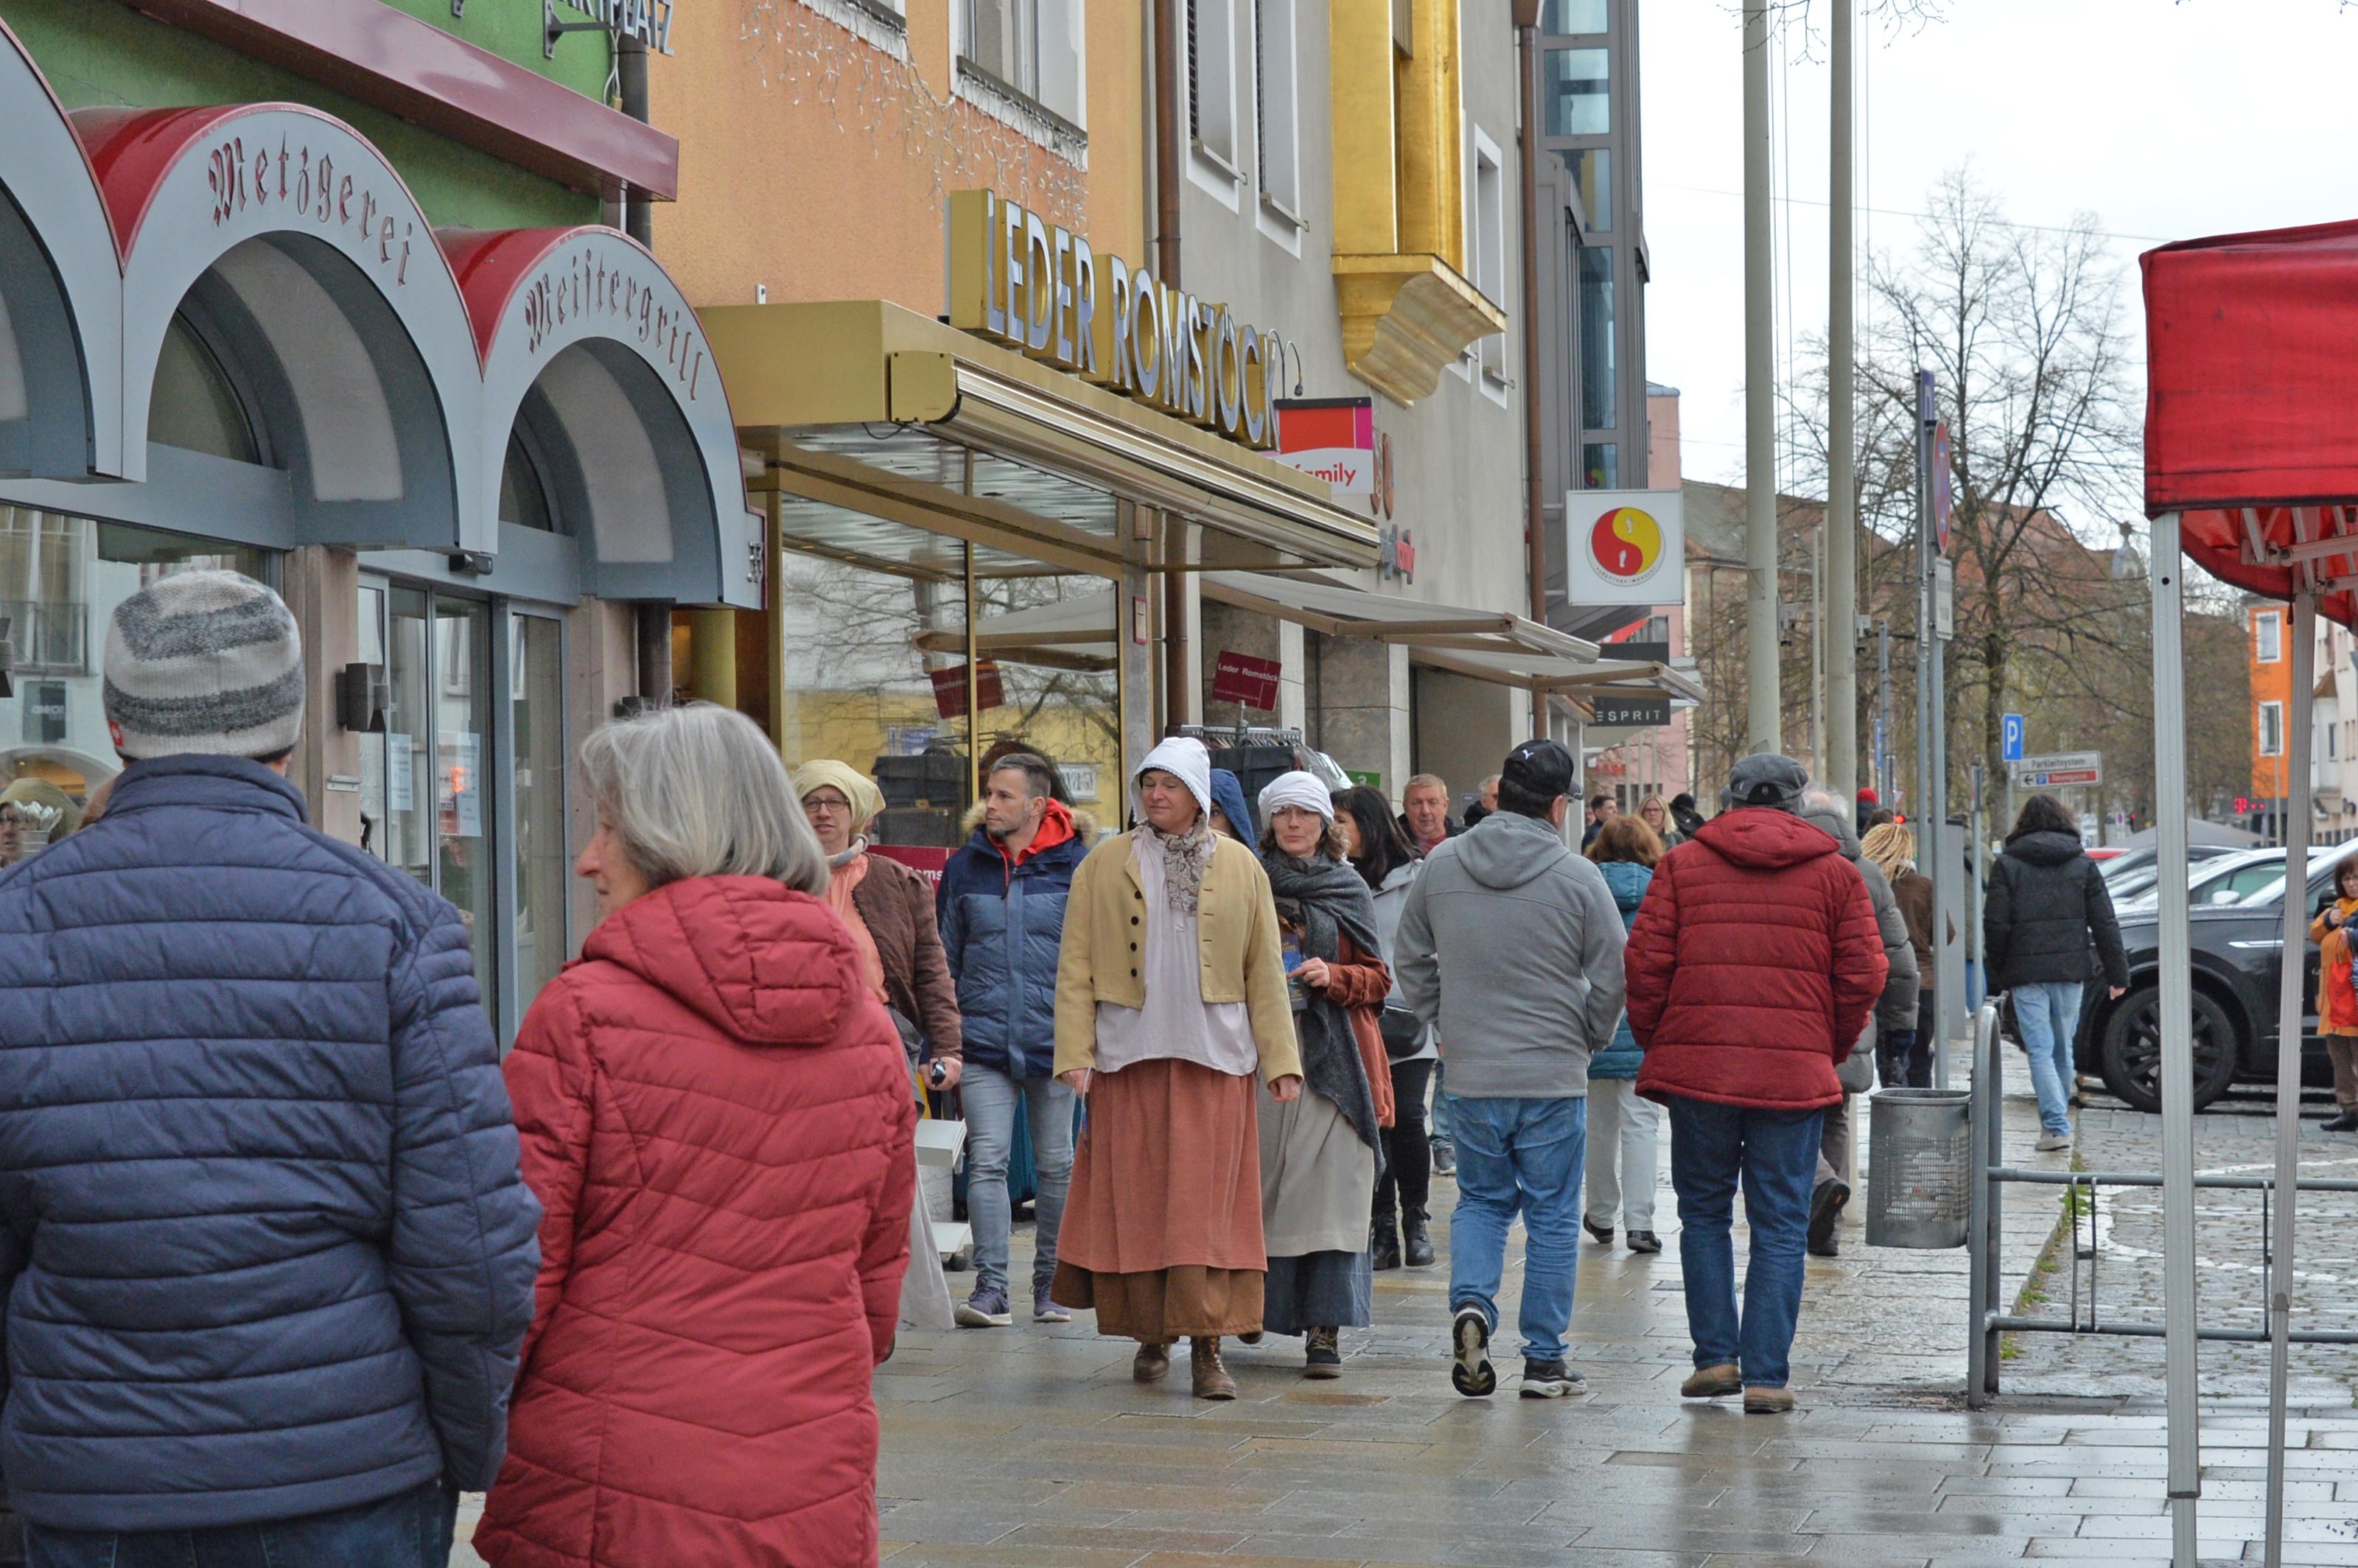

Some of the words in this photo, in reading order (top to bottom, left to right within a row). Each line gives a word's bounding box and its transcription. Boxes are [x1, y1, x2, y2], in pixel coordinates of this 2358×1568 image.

[207, 128, 413, 287] Metzgerei
[987, 188, 1097, 374] LEDER
[1110, 253, 1281, 453] ROMSTÖCK
[1295, 461, 1357, 487] mily
[1218, 662, 1239, 674] Leder
[1242, 667, 1278, 682] Romstöck
[1595, 710, 1661, 722] ESPRIT
[2007, 720, 2018, 755] P
[2031, 757, 2086, 771] Parkleitsystem
